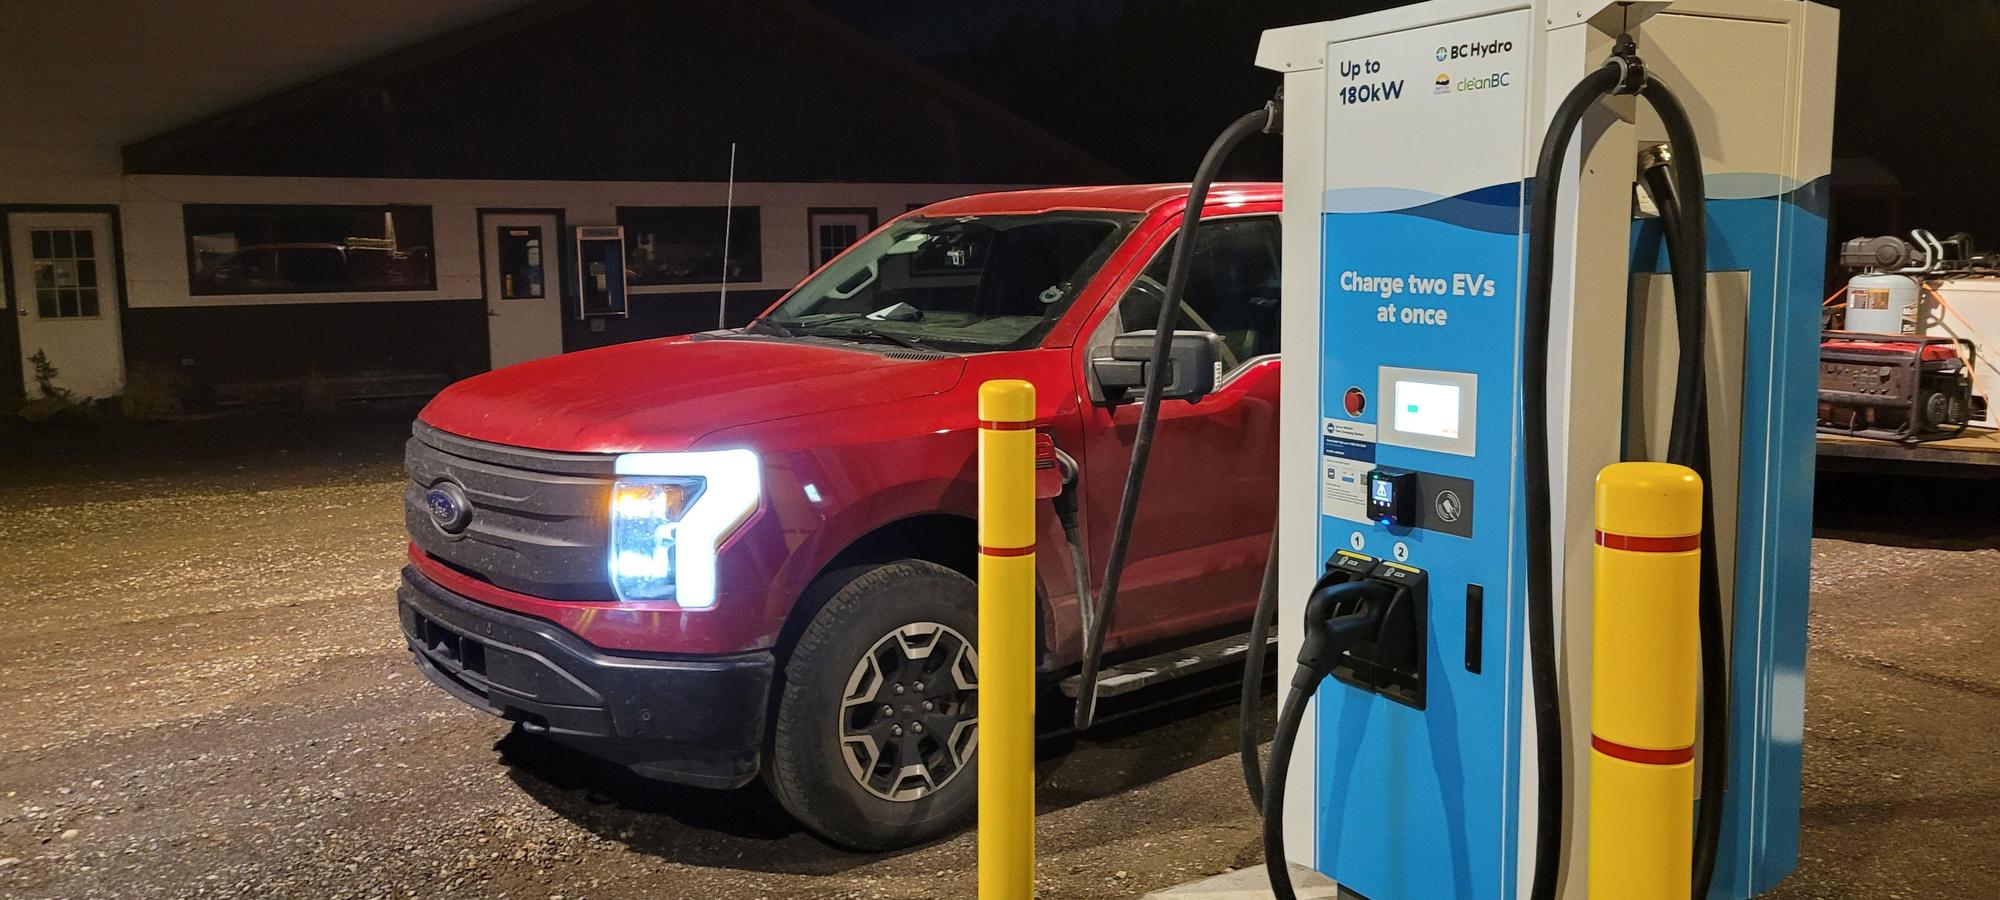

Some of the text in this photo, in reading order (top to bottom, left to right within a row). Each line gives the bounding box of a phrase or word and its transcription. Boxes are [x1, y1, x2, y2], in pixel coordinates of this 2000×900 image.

[1451, 40, 1513, 59] BC Hydro
[1340, 59, 1380, 81] Up to
[1339, 80, 1405, 105] 180kW
[1457, 72, 1510, 91] cleanBC
[1340, 271, 1496, 298] Charge two EVs
[1377, 303, 1448, 326] at once
[1398, 547, 1404, 557] 2
